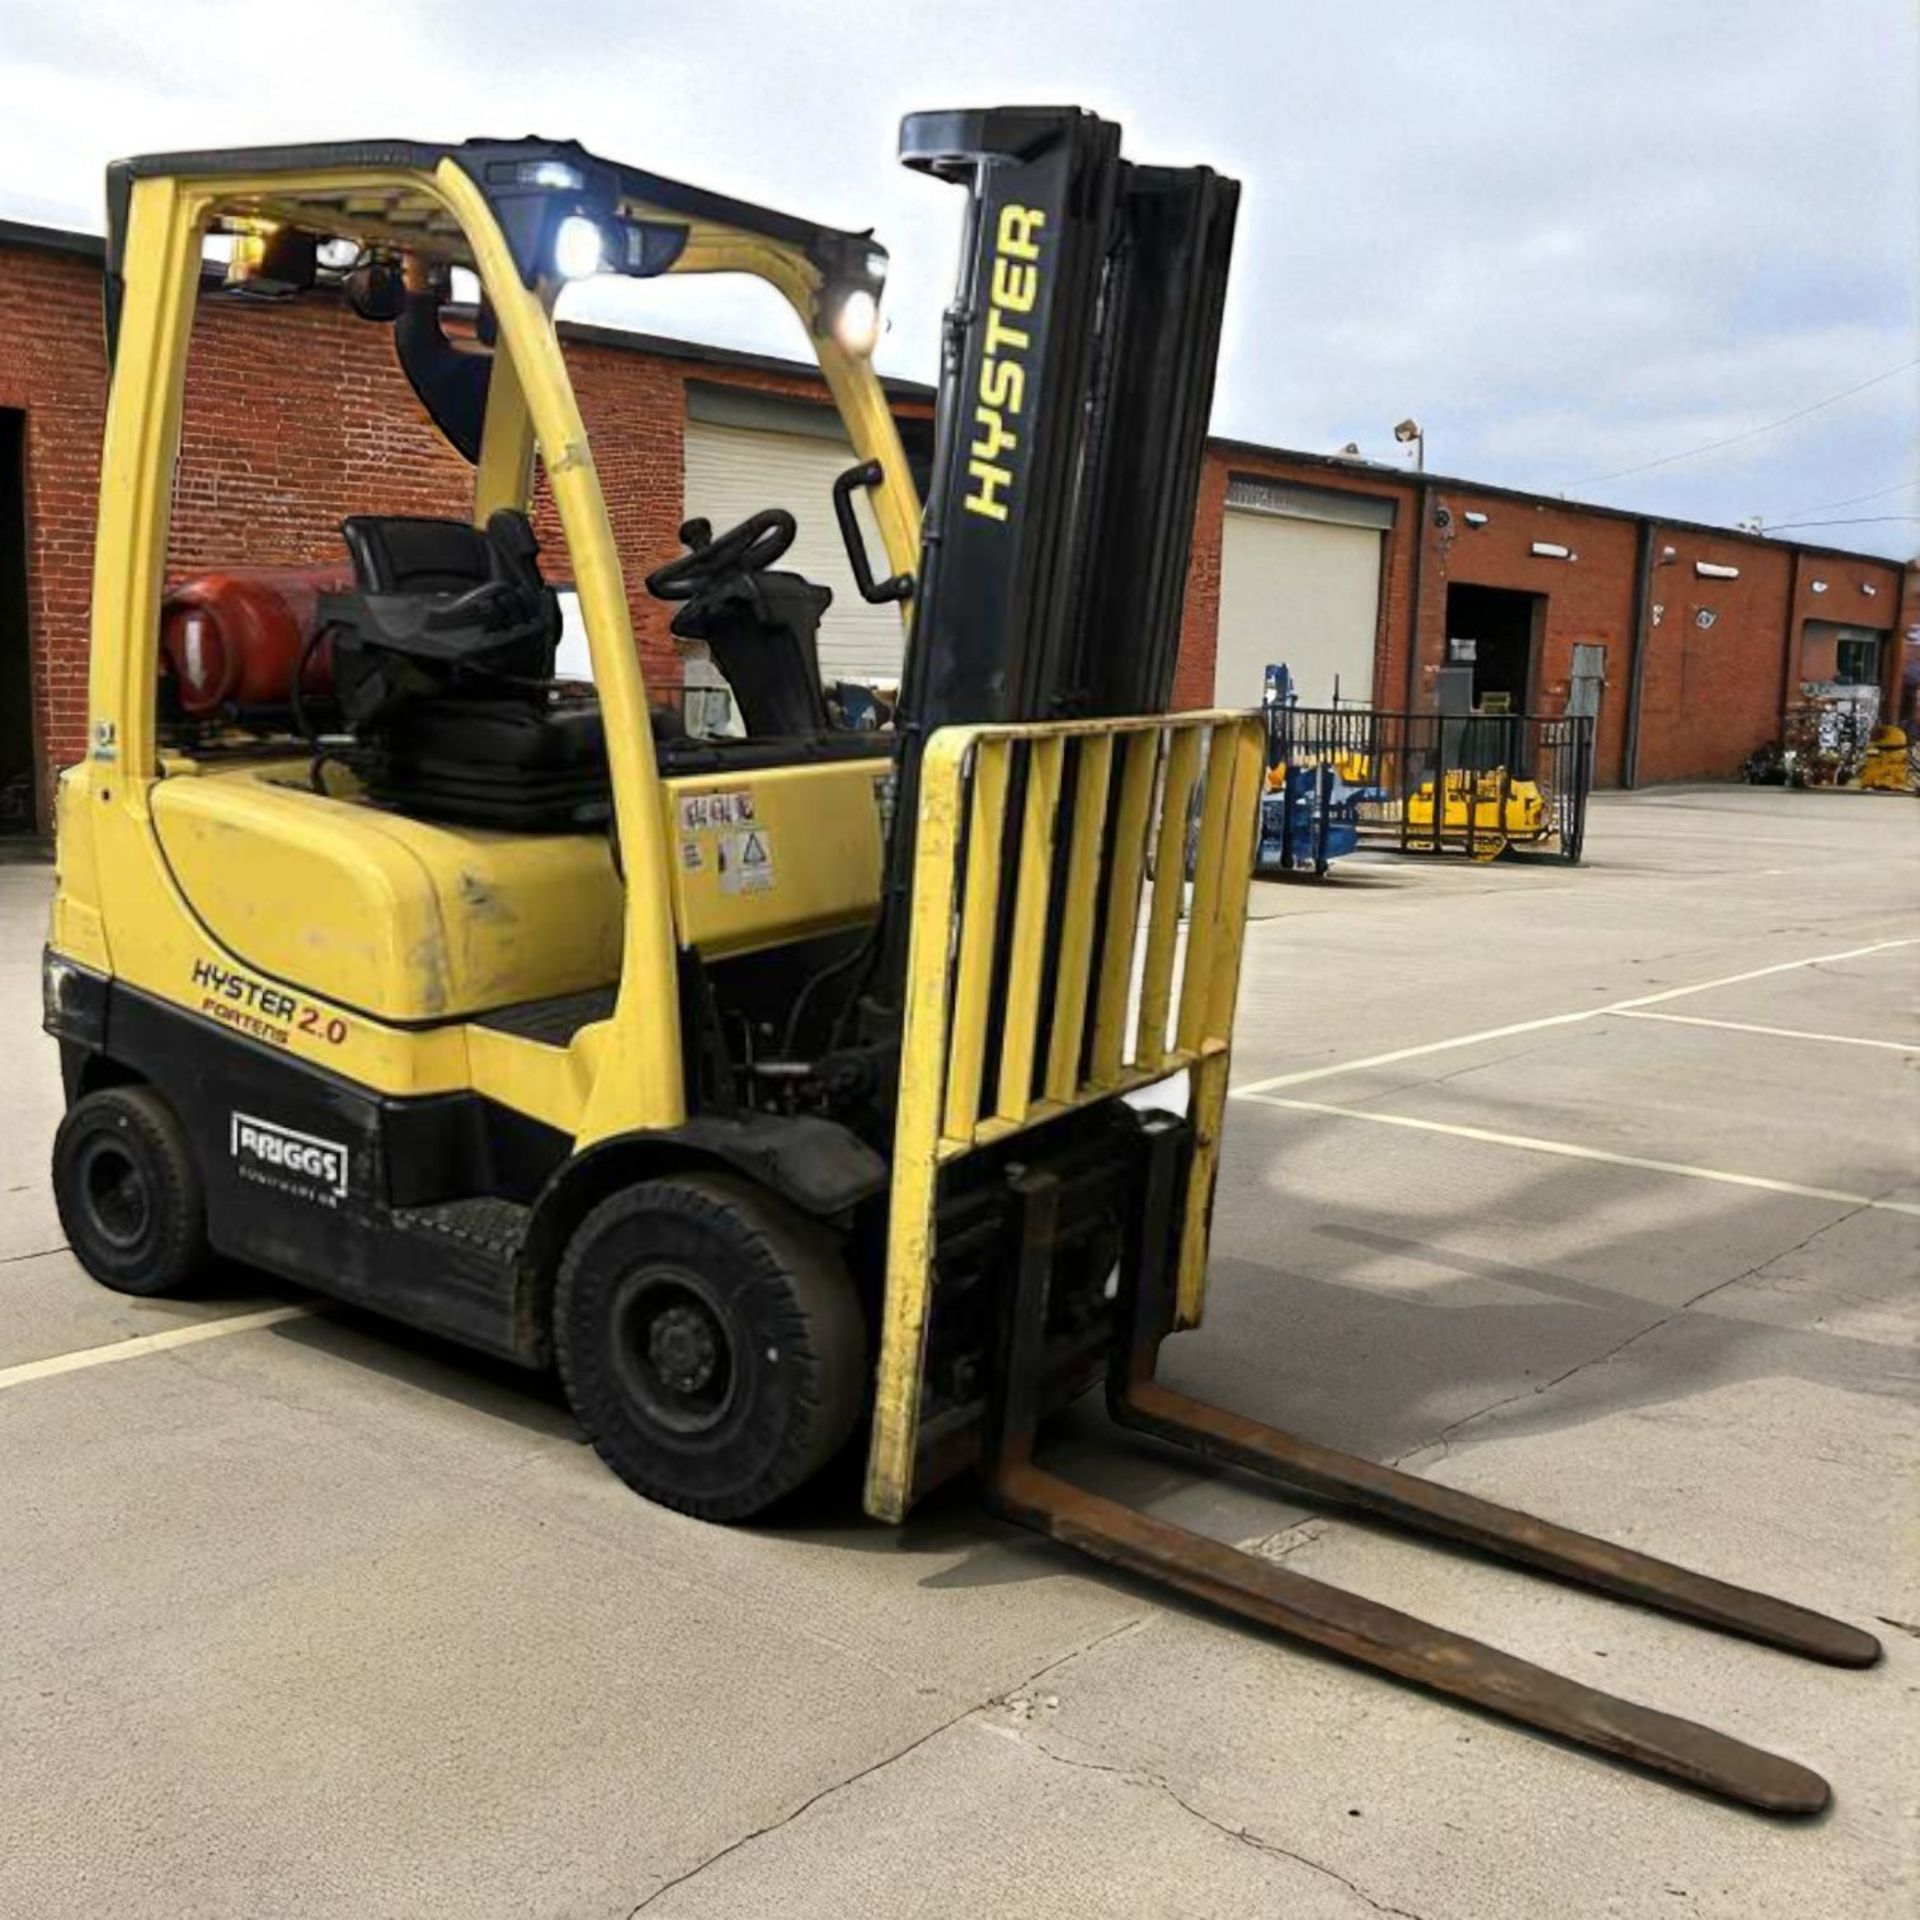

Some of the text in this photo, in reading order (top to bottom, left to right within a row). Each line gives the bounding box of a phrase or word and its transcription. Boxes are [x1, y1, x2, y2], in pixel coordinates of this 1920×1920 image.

[964, 203, 1046, 521] HYSTER
[192, 959, 346, 1044] HYSTER 2.0
